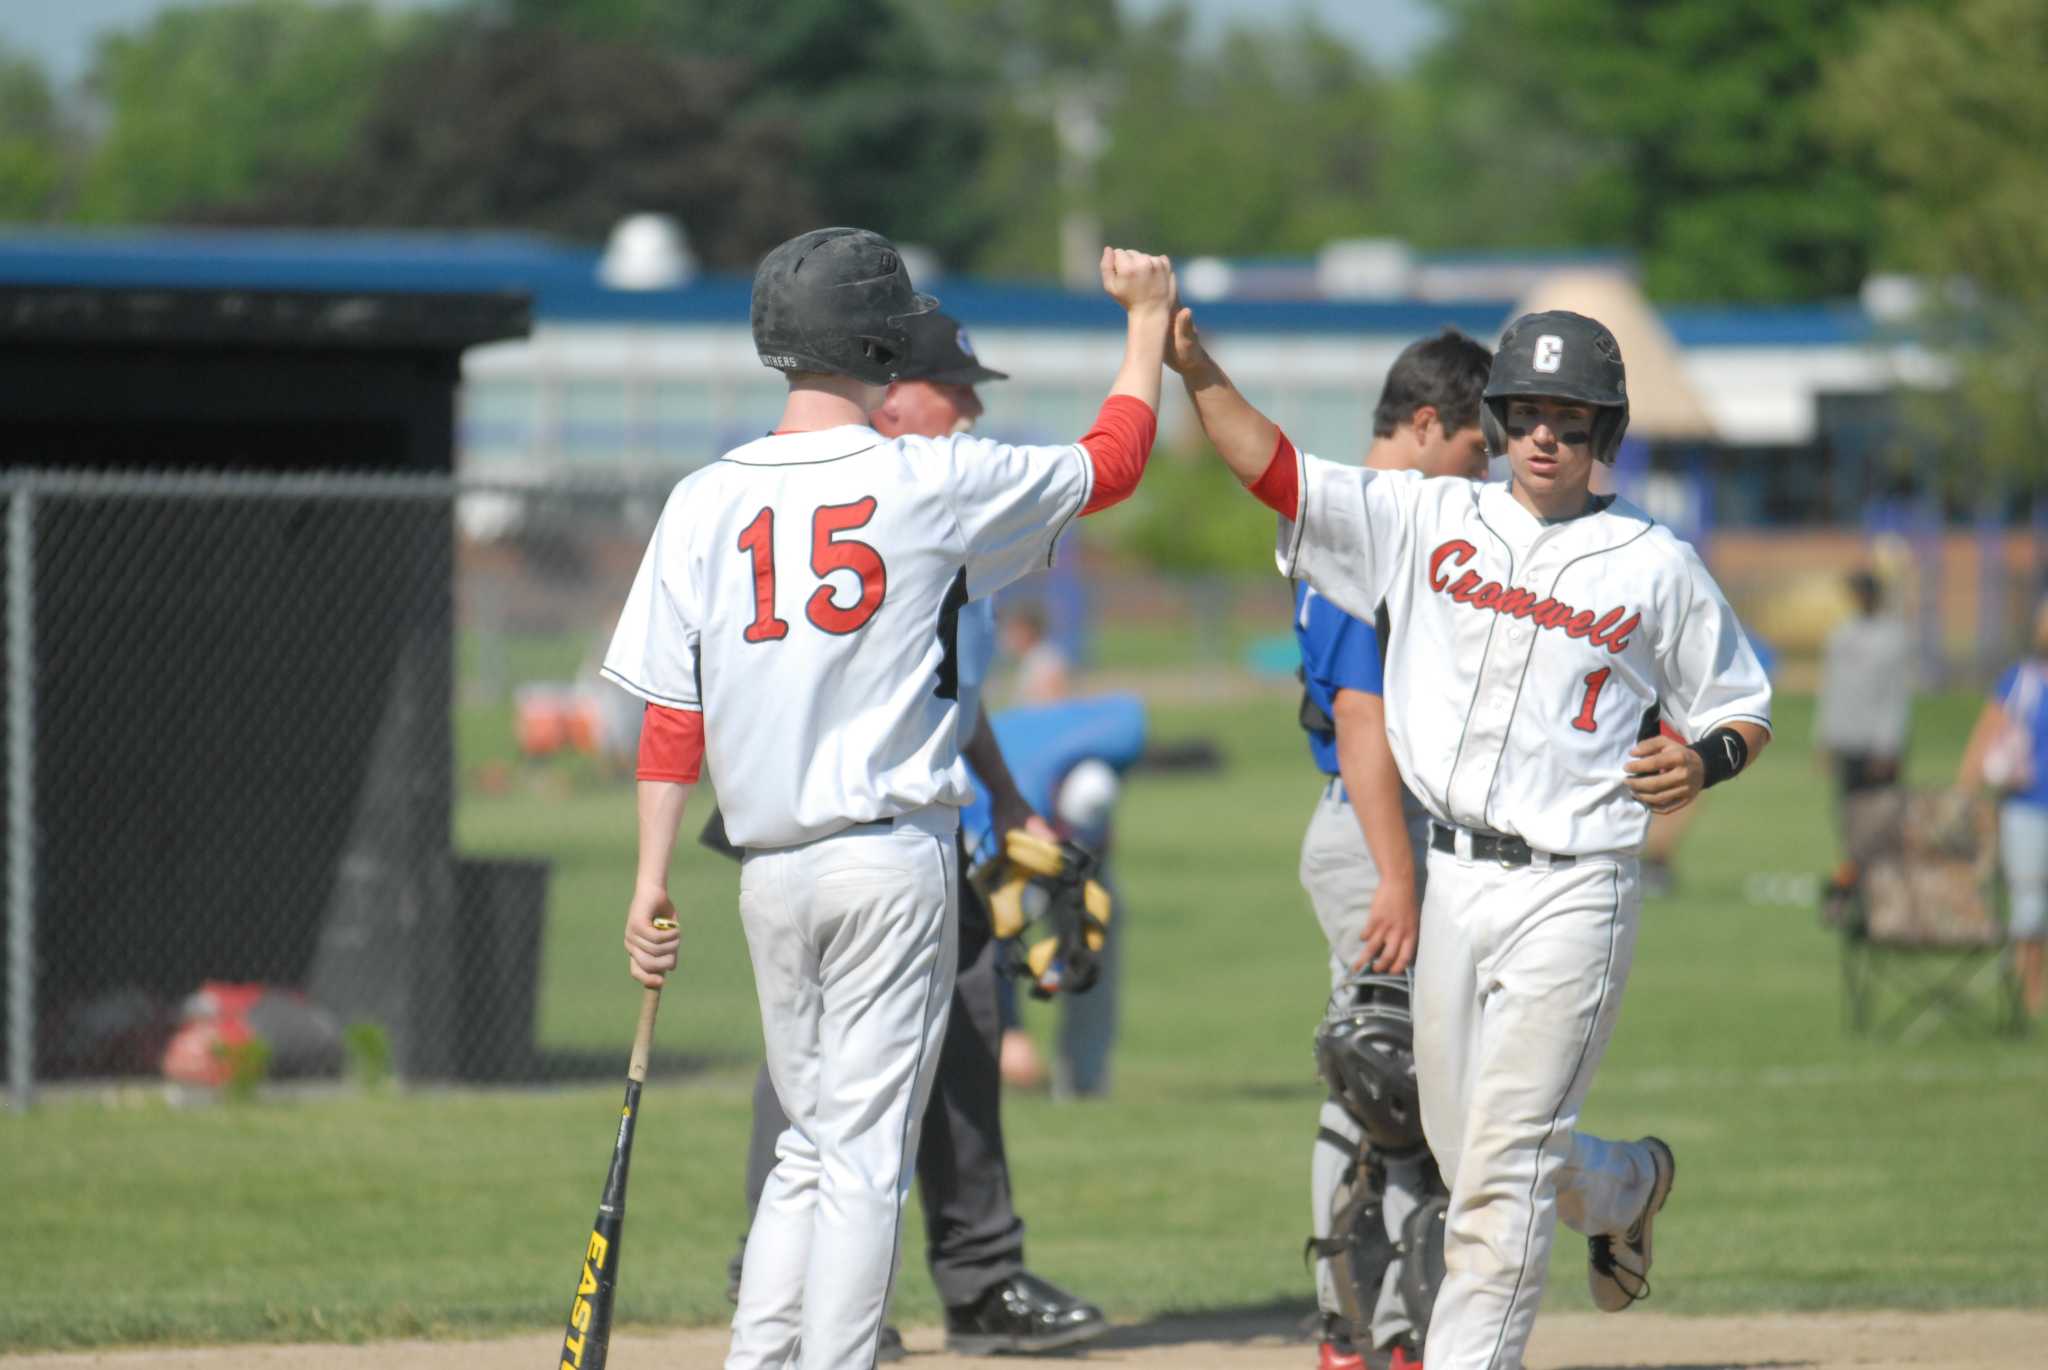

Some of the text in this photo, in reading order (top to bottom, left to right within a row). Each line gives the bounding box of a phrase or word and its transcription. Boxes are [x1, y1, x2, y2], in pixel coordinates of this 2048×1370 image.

[1533, 334, 1564, 373] C
[737, 495, 887, 643] 15
[1429, 539, 1641, 654] Cromwell
[1571, 666, 1612, 734] 1
[561, 1230, 609, 1370] EAST
